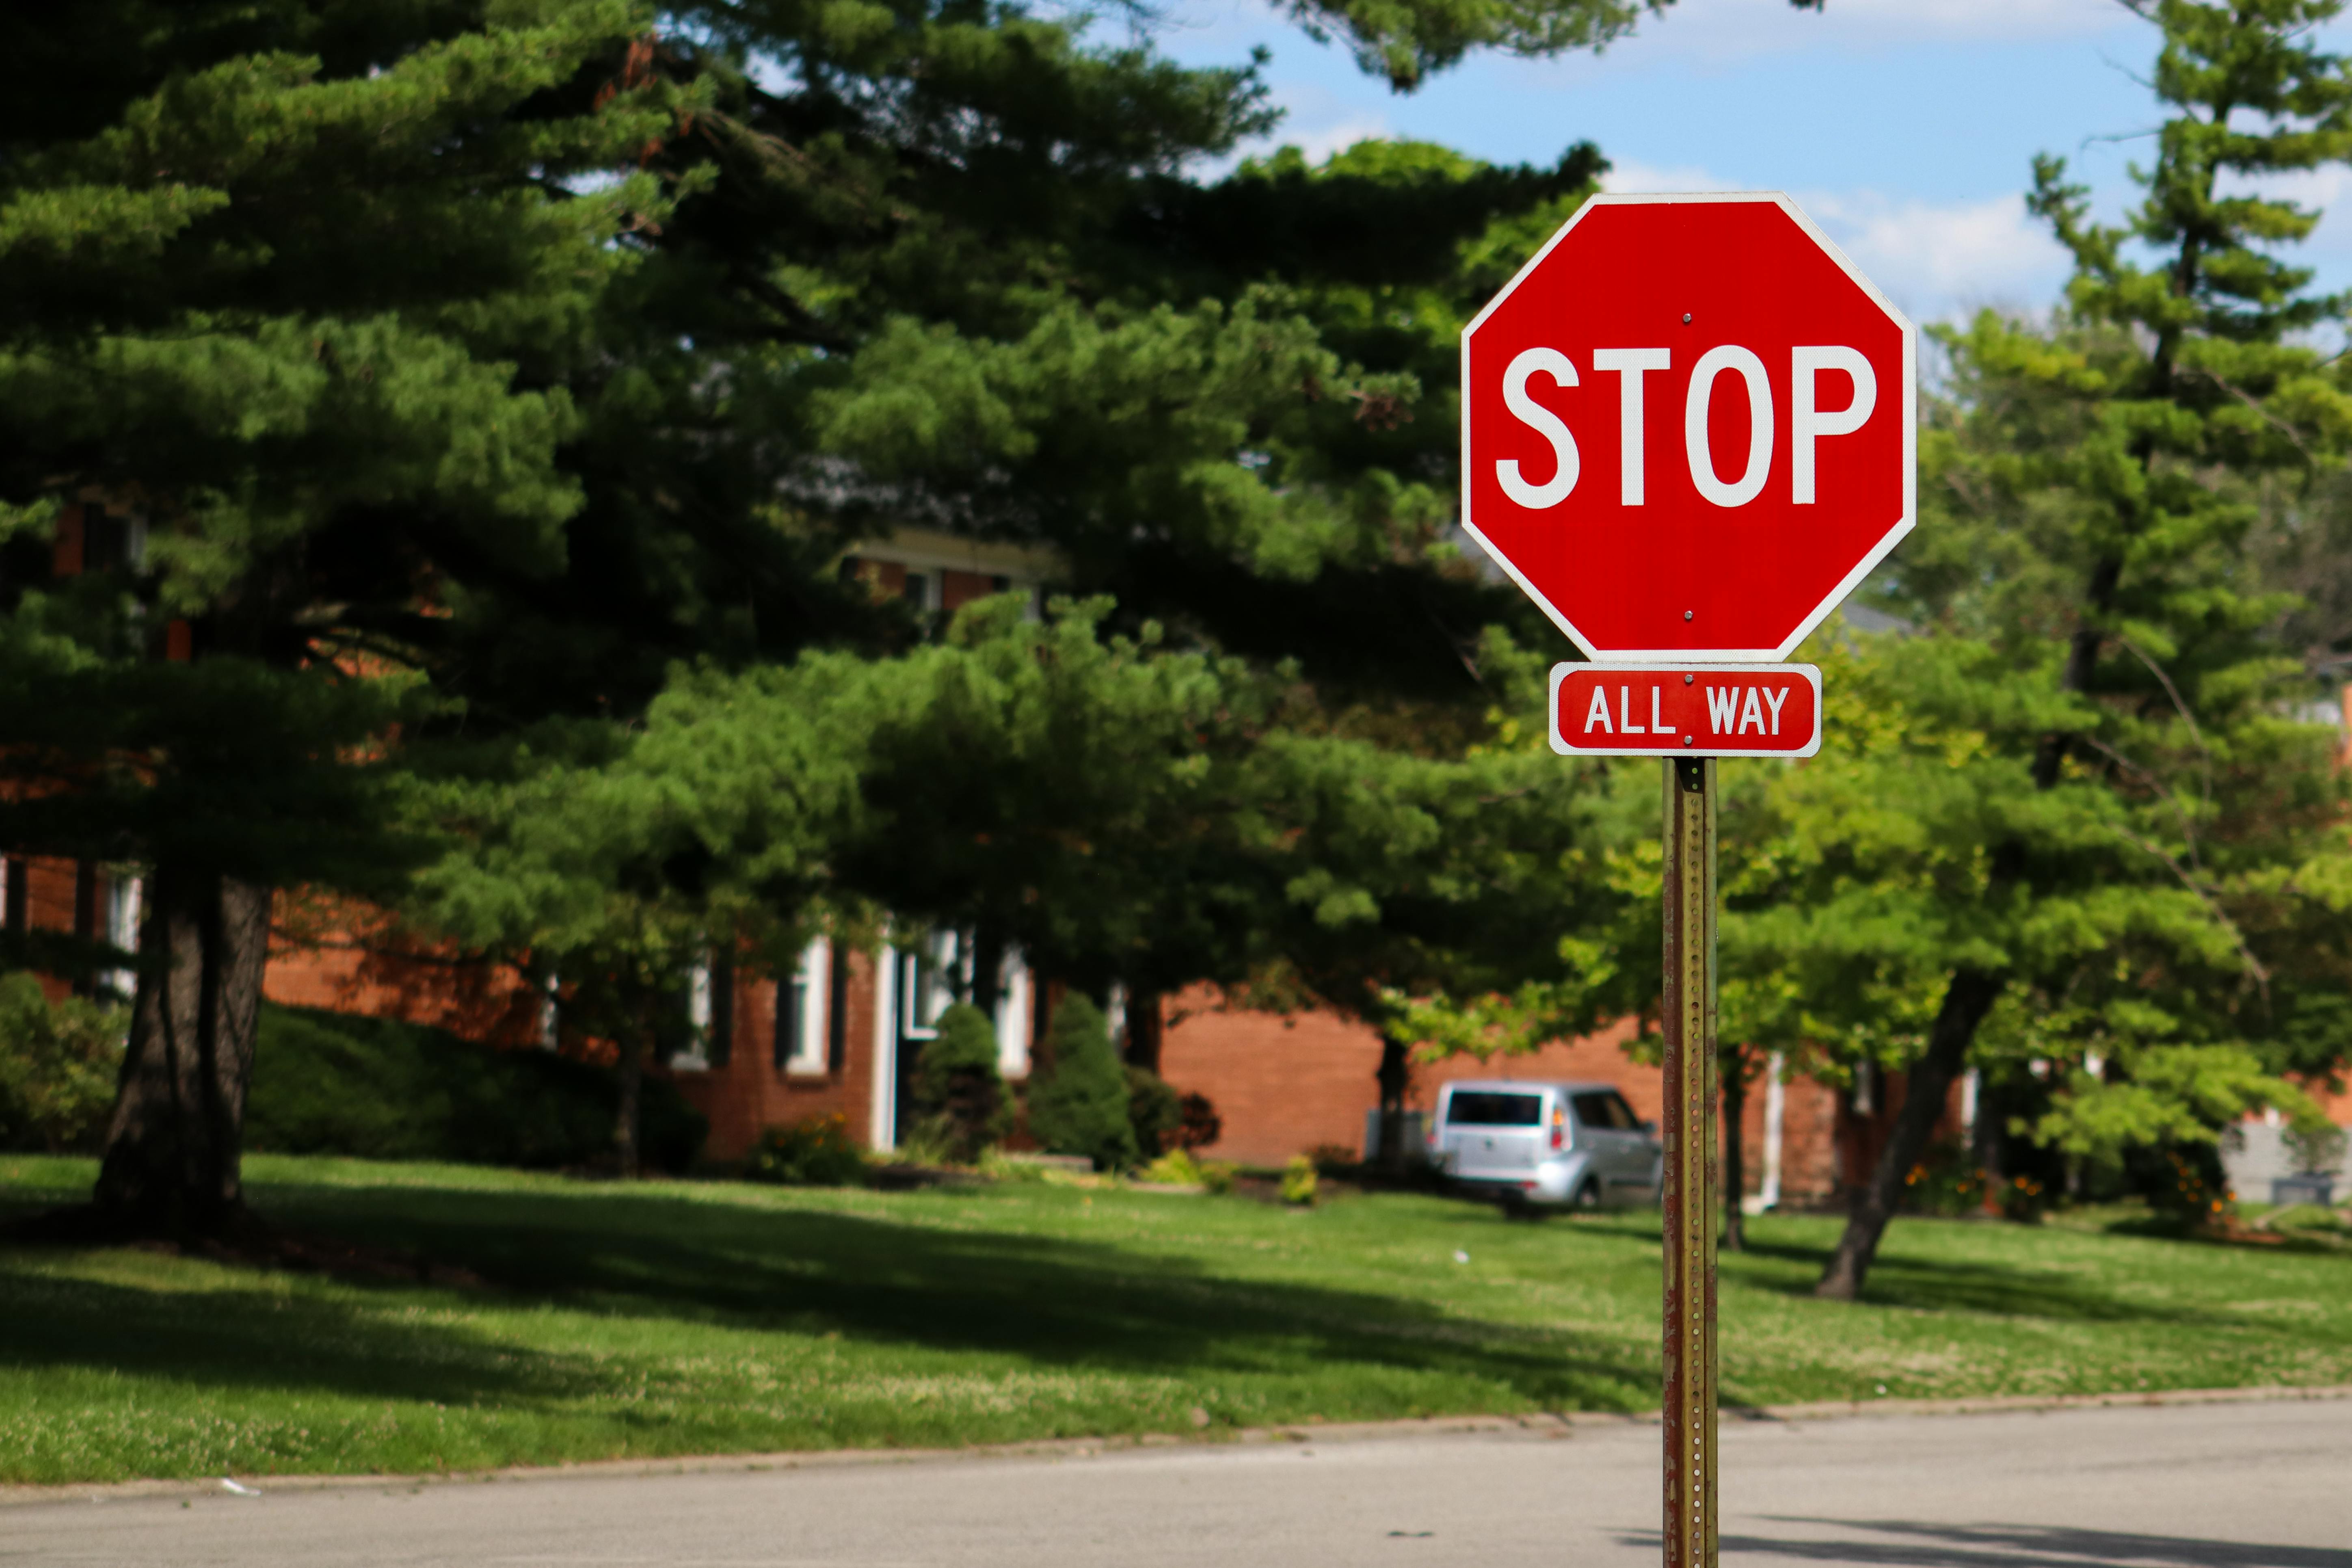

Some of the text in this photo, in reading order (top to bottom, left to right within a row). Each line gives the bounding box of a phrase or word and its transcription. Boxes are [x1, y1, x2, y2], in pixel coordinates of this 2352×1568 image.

[1496, 345, 1876, 509] STOP
[1584, 686, 1789, 735] ALL WAY
